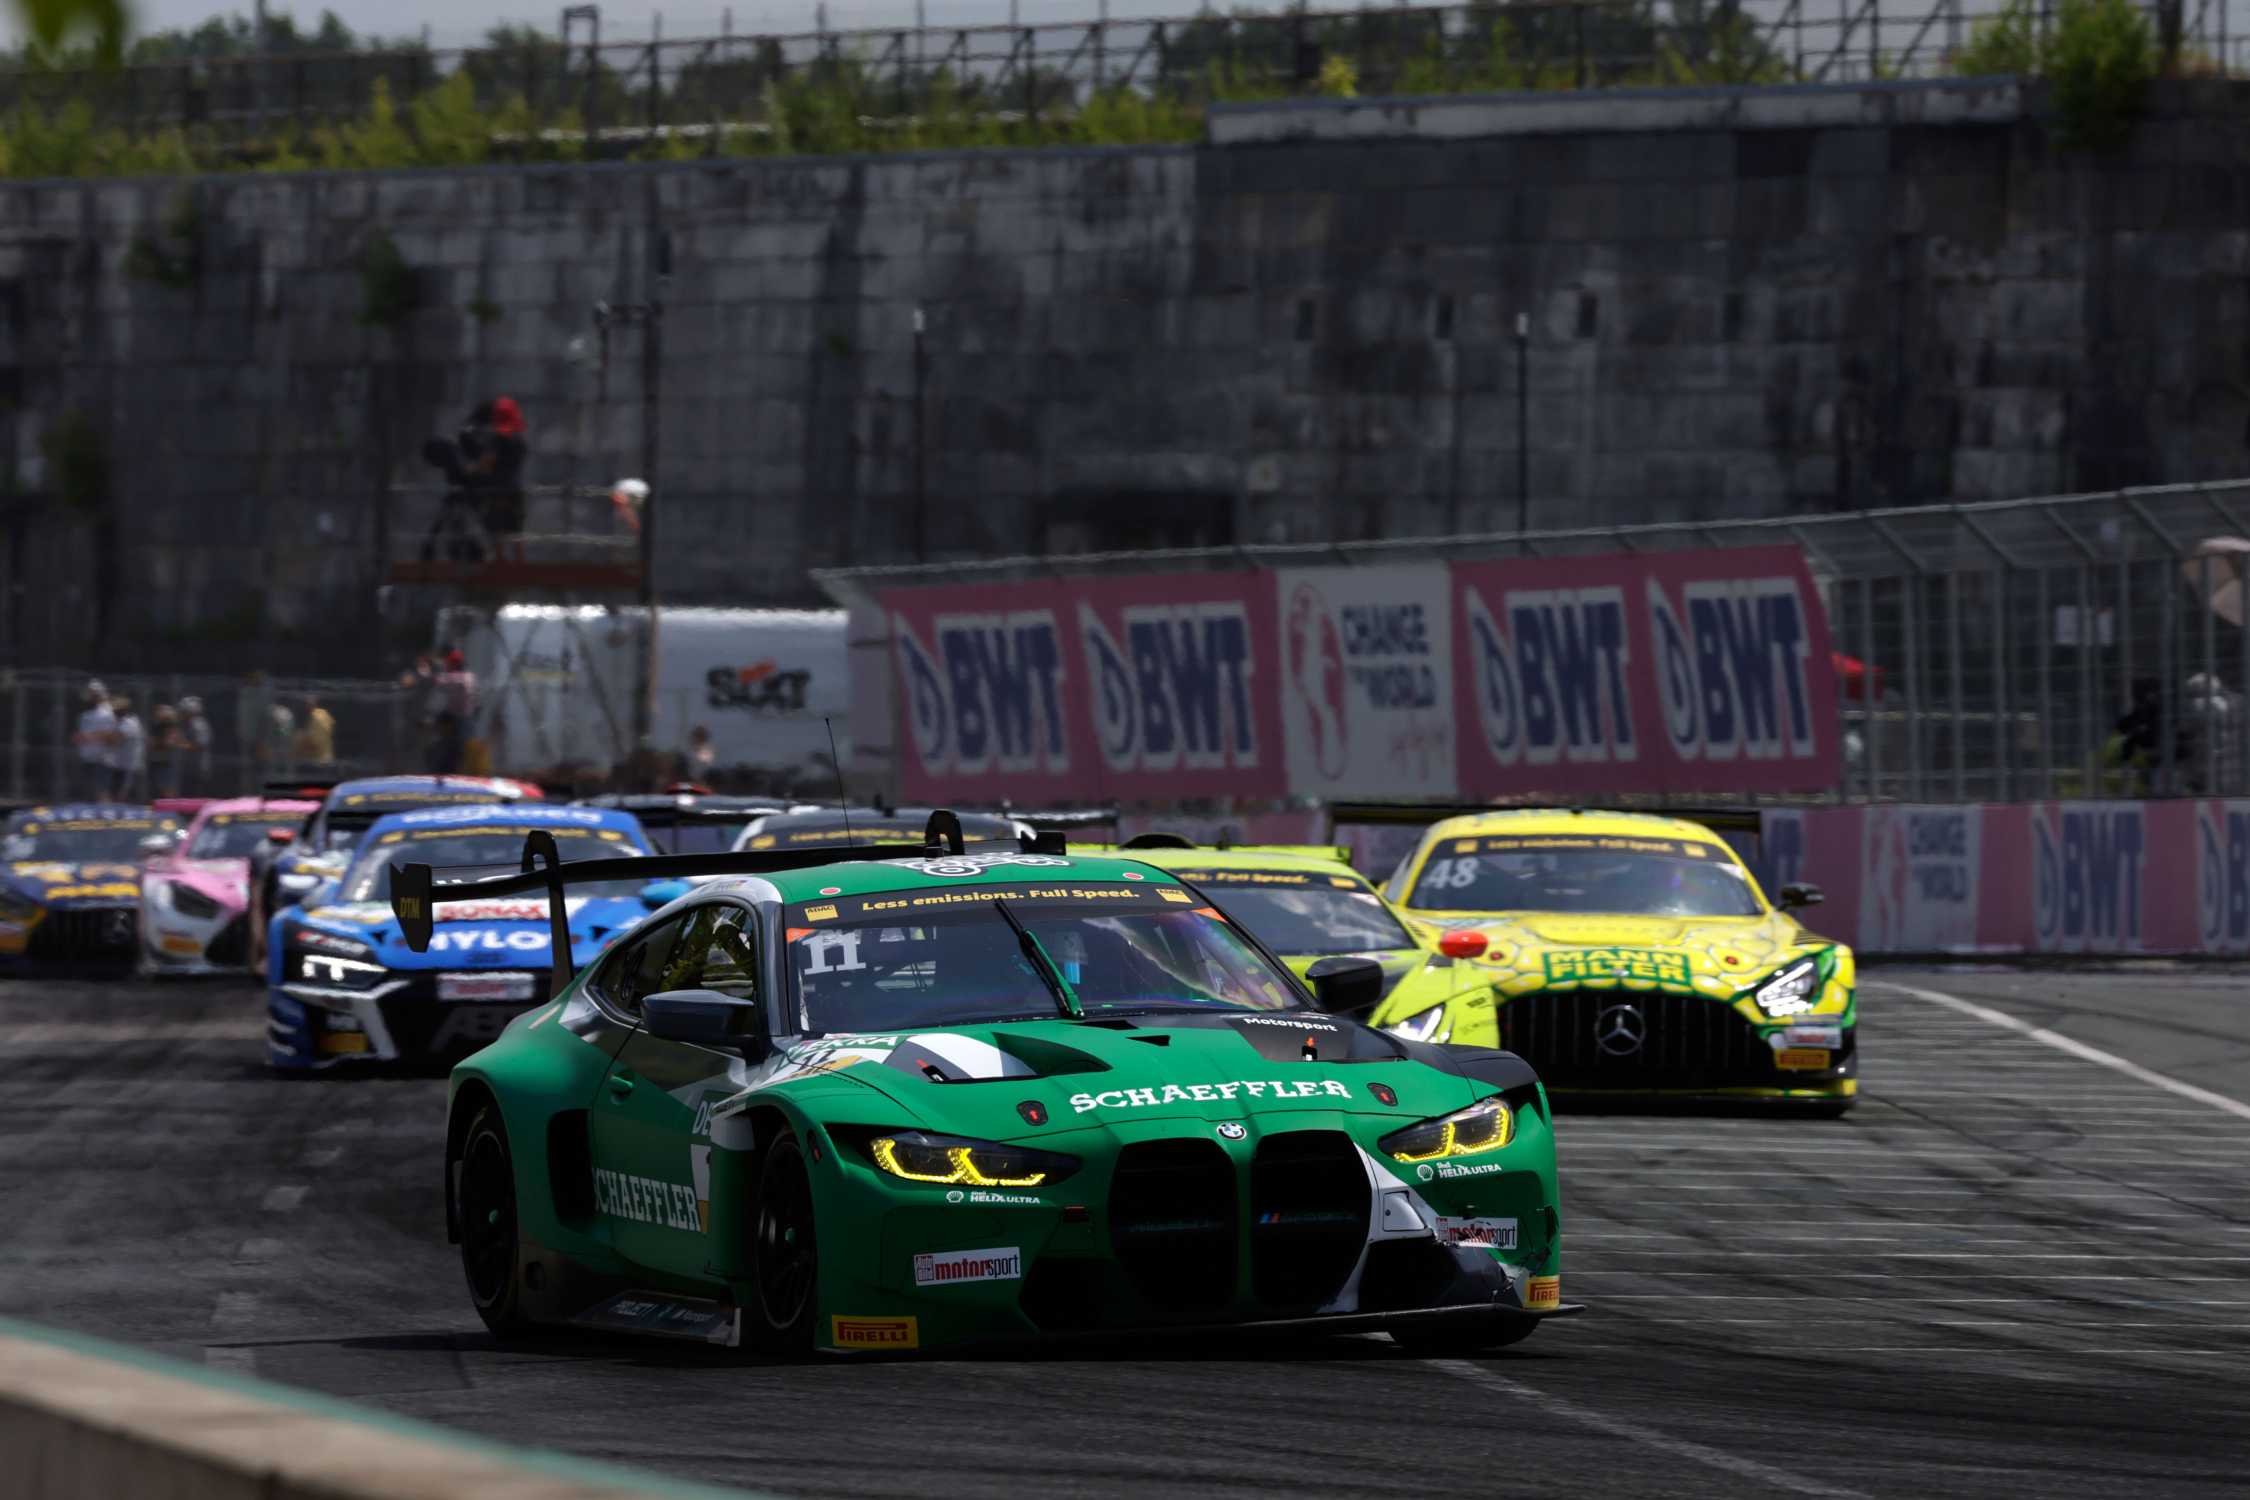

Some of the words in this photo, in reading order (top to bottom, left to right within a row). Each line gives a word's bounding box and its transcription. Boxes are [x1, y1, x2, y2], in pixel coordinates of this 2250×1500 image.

[1508, 591, 1636, 759] BWT
[1686, 582, 1812, 755] BWT
[936, 612, 1067, 772] BWT
[1124, 605, 1256, 765] BWT
[1423, 857, 1479, 889] 48
[862, 901, 908, 911] Less
[913, 891, 1025, 905] emissions.
[1029, 889, 1068, 899] Full
[1071, 888, 1140, 900] Speed.
[804, 931, 866, 975] 11
[1549, 949, 1684, 966] MANN
[1550, 961, 1686, 981] FILTER
[1243, 1017, 1338, 1032] Motorsport
[1069, 1080, 1353, 1113] SCHAEFFLER
[1471, 1163, 1502, 1174] ULTRA
[1006, 1196, 1040, 1204] ULTRA
[837, 1321, 908, 1341] PIRELLI
